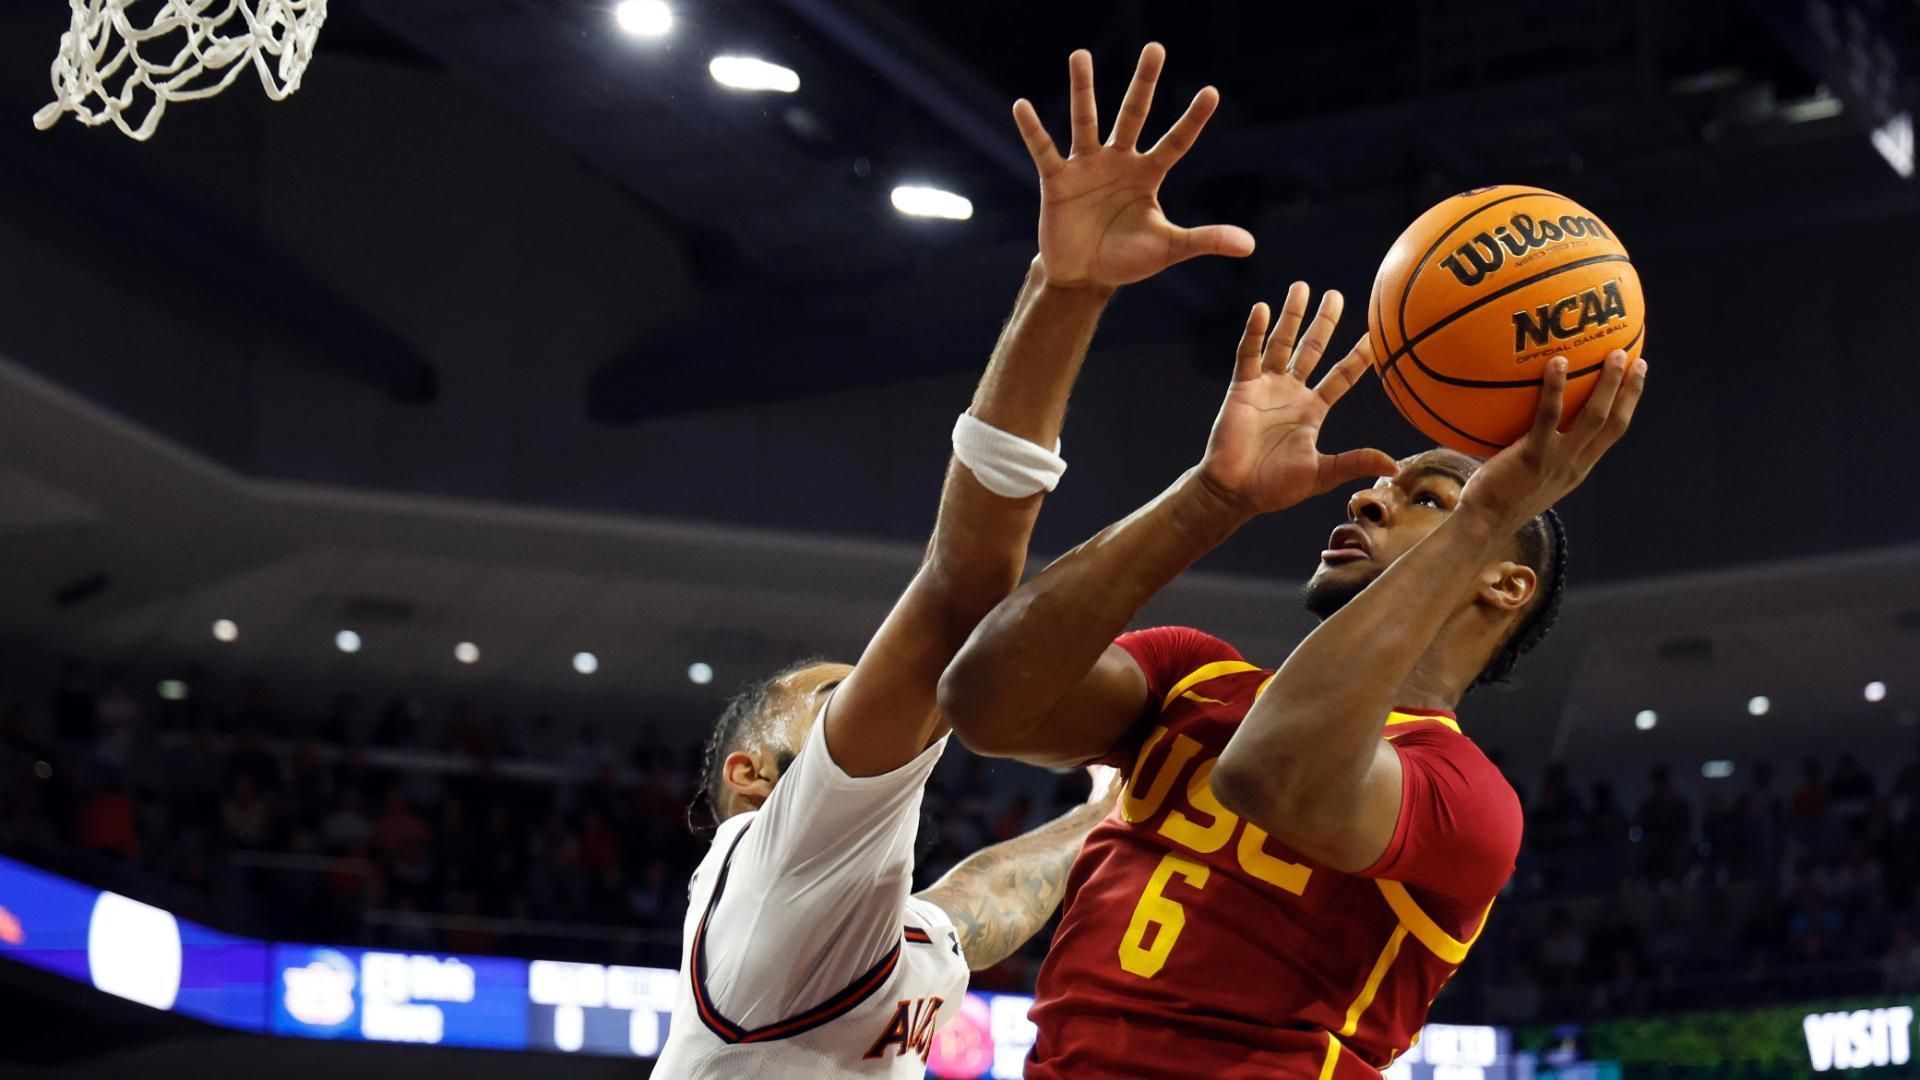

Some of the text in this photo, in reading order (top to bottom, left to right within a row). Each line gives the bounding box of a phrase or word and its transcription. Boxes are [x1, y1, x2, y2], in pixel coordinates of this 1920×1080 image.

[1440, 213, 1610, 286] Wilson
[1512, 280, 1626, 353] NCAA
[1516, 322, 1628, 364] OFFICIAL GAME BALL
[1118, 852, 1210, 979] 6
[1803, 1006, 1914, 1072] VISIT
